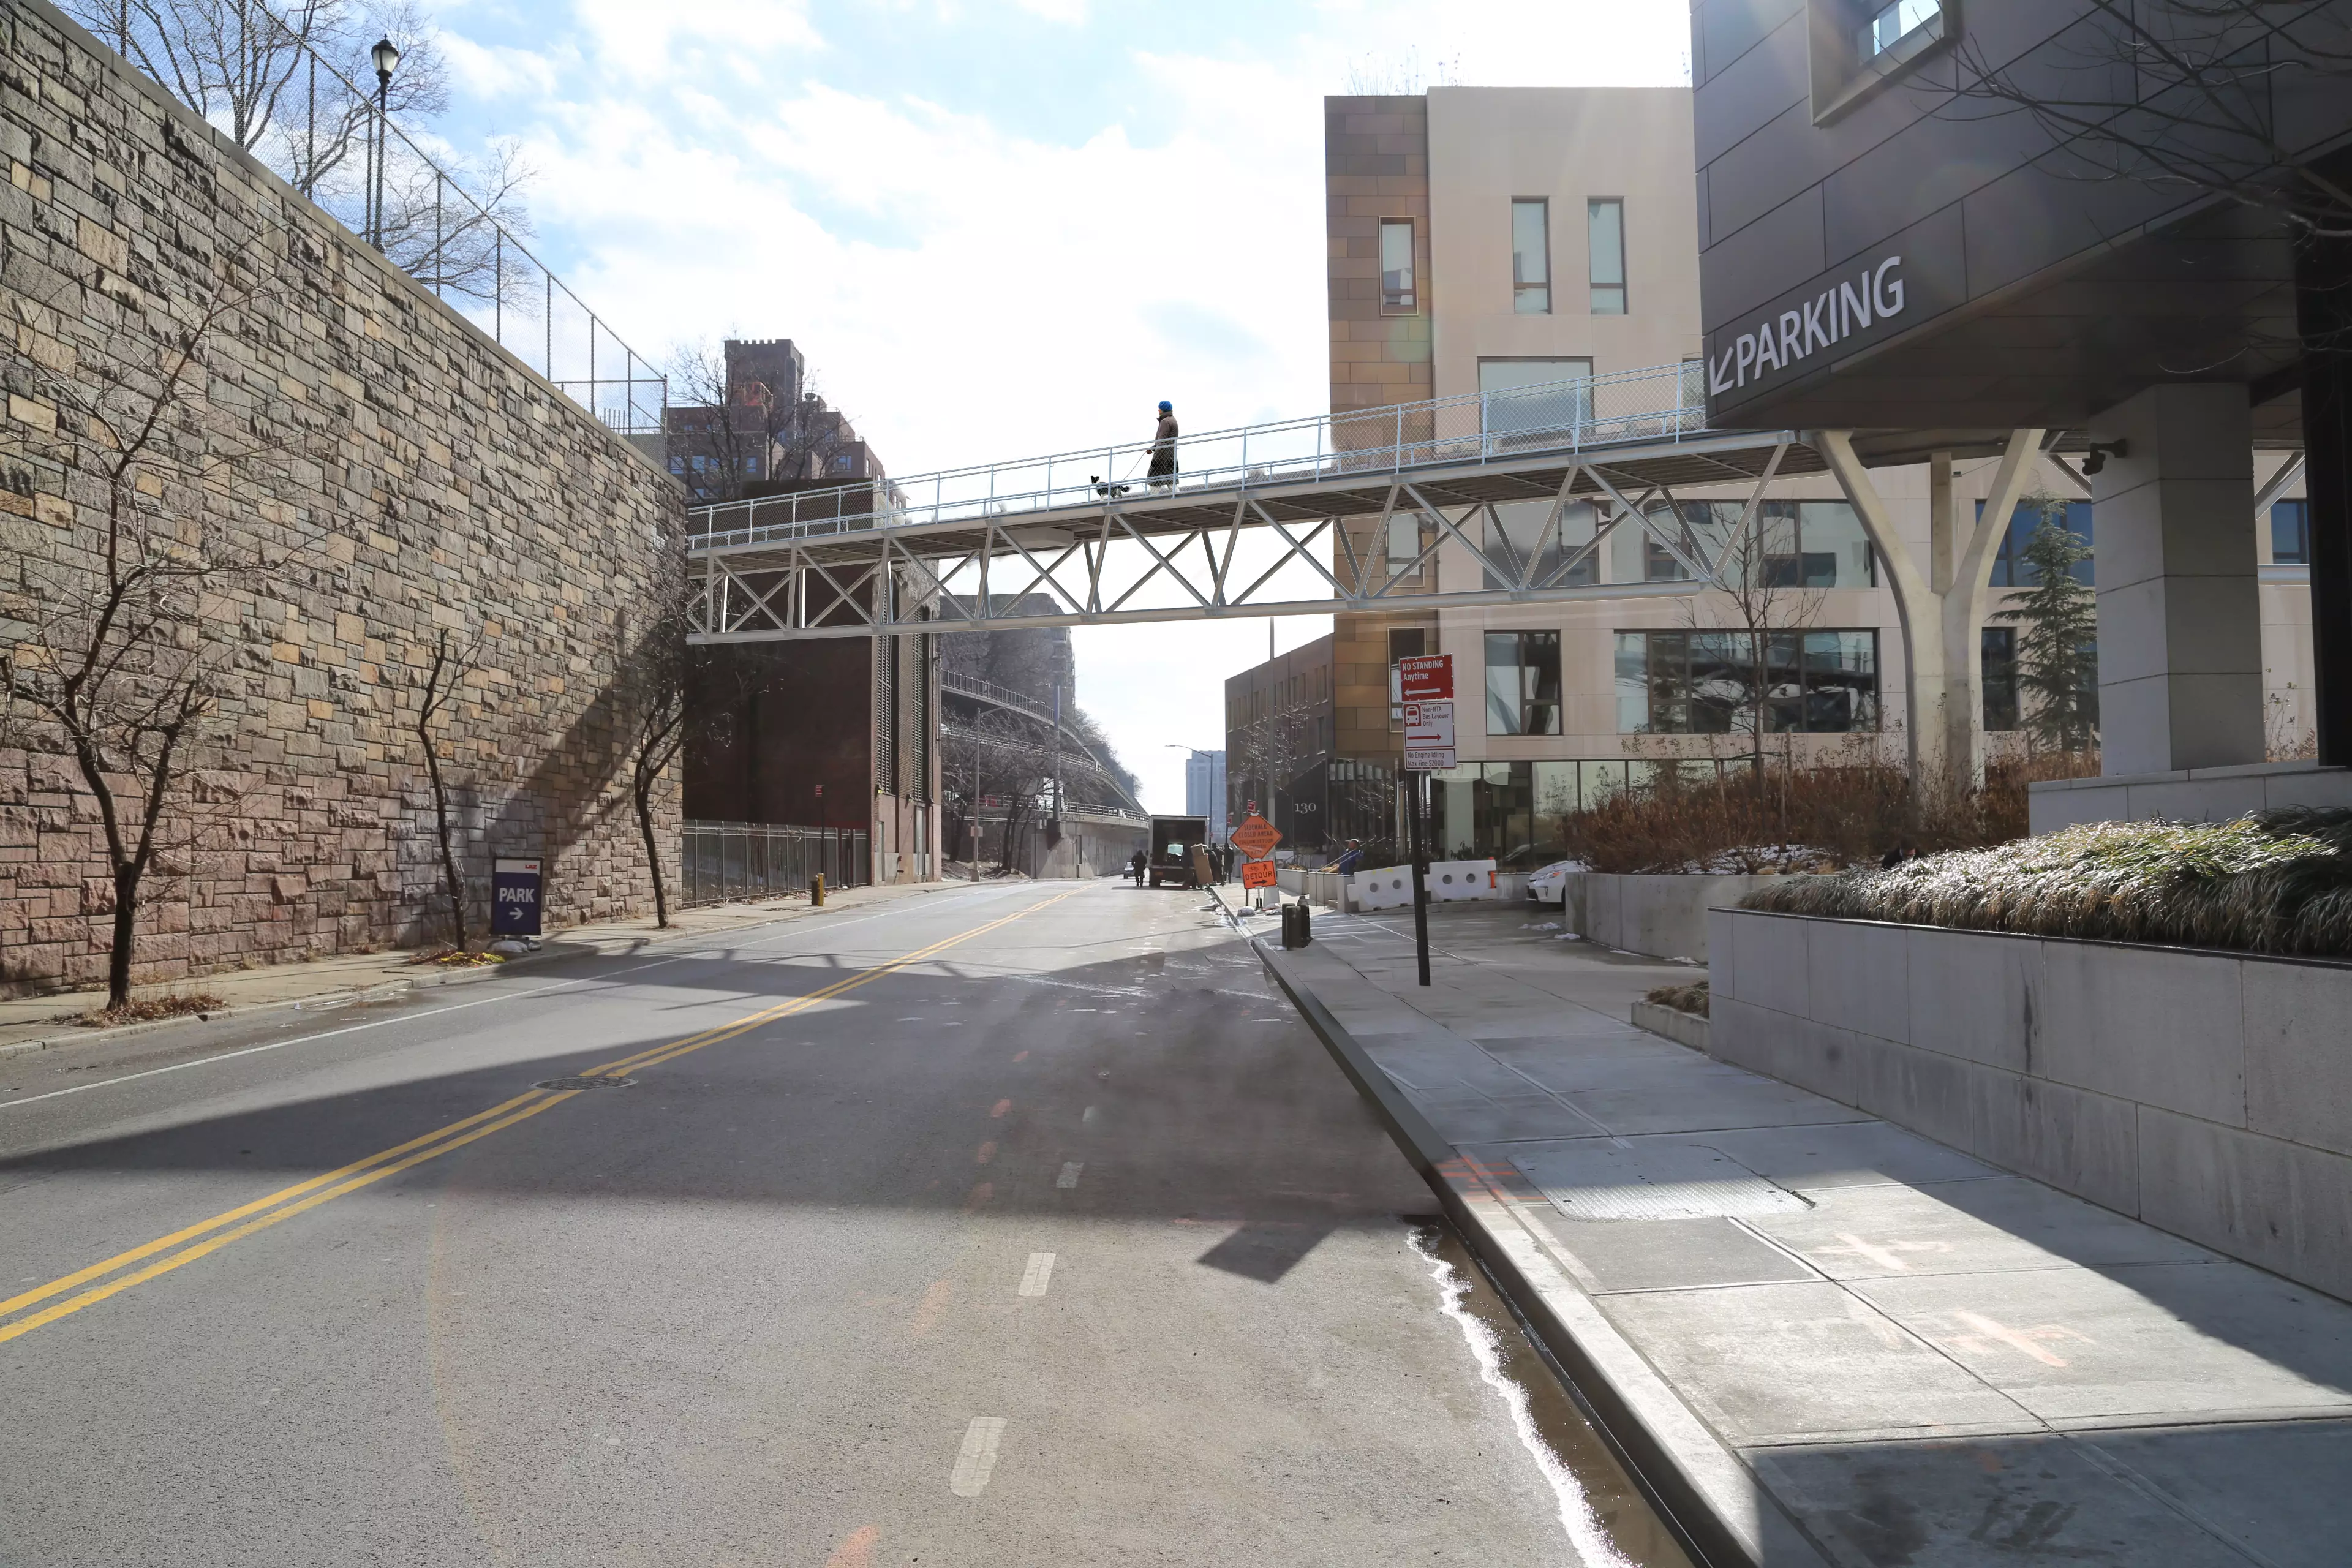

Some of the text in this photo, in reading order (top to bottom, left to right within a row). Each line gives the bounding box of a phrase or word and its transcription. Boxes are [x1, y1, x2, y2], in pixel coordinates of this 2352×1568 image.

[1736, 256, 1904, 388] PARKING
[1402, 660, 1444, 671] NO STANDING
[1403, 672, 1429, 682] Anytime
[1294, 802, 1316, 814] 130
[1245, 872, 1273, 880] DETOUR
[499, 887, 535, 903] PARK
